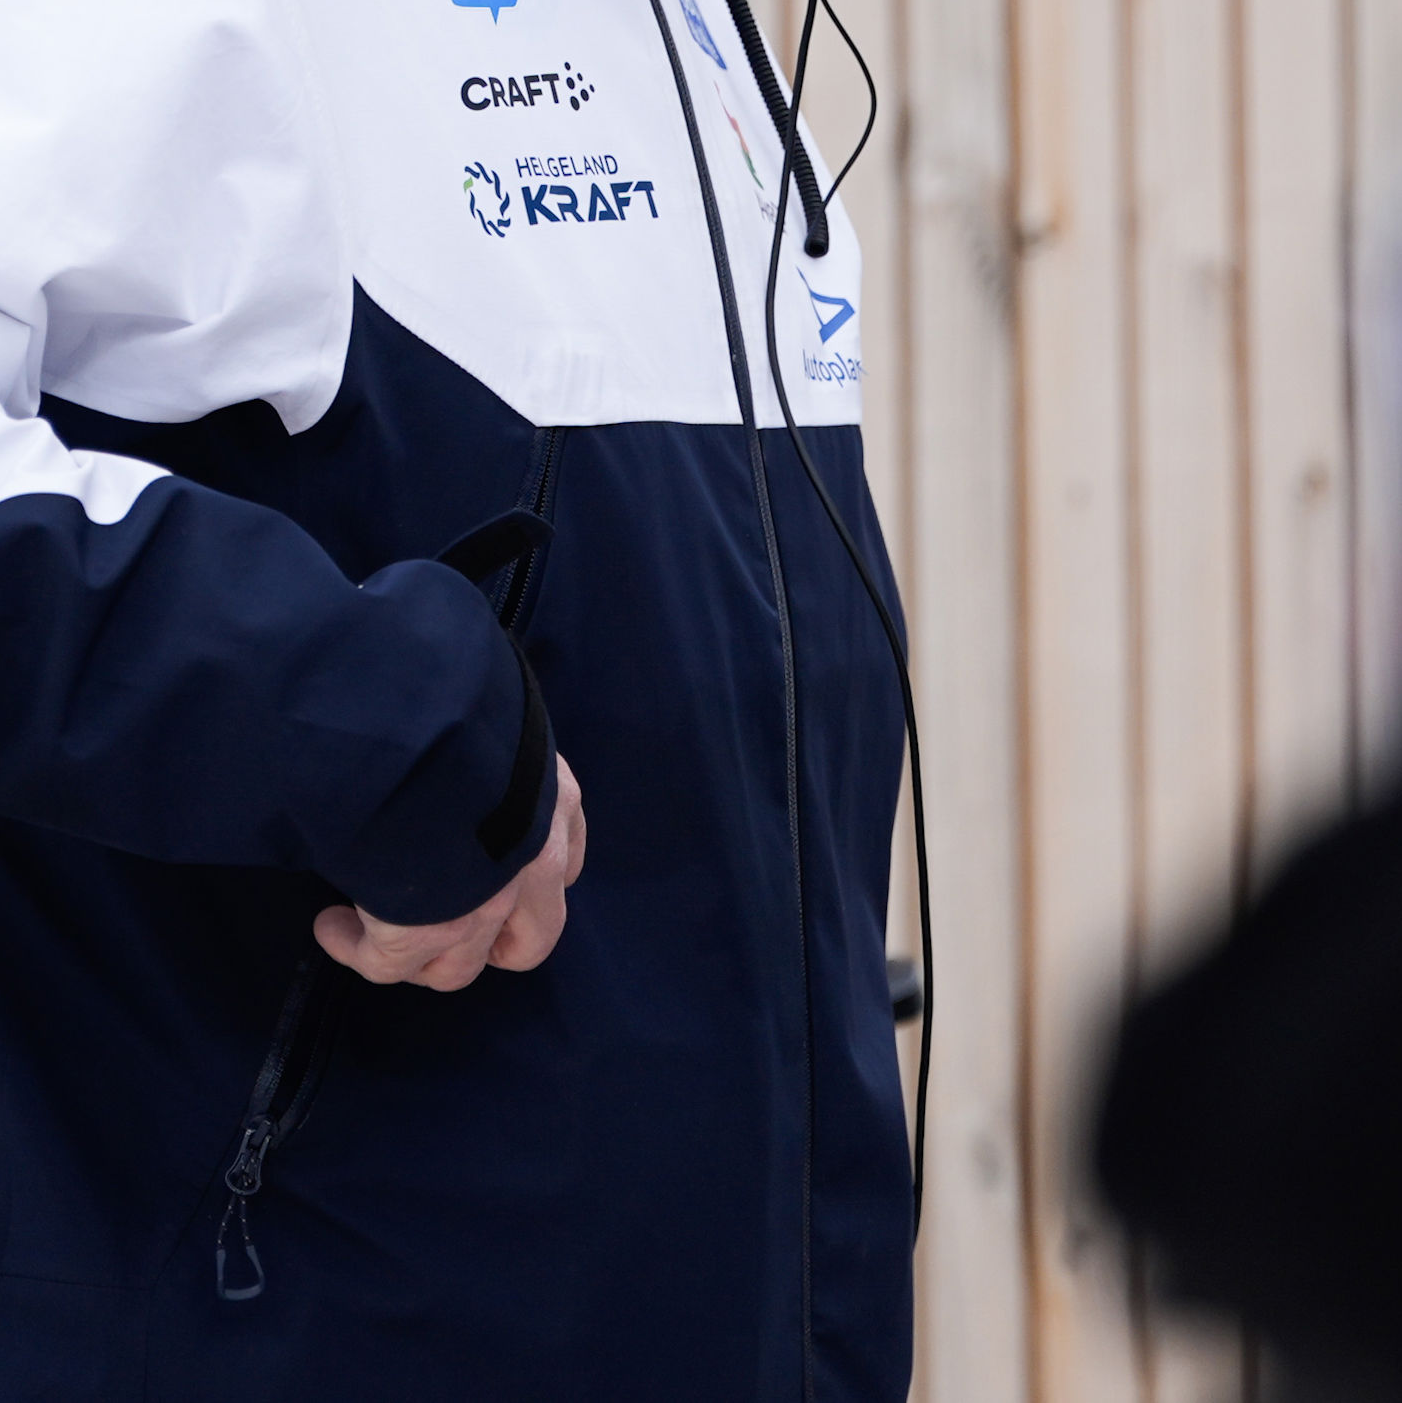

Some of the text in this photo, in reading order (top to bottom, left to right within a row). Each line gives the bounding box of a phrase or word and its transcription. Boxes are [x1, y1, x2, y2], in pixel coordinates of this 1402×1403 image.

[460, 73, 560, 112] CRAFT
[515, 154, 619, 178] HELGELAND
[521, 180, 659, 226] KRAFT
